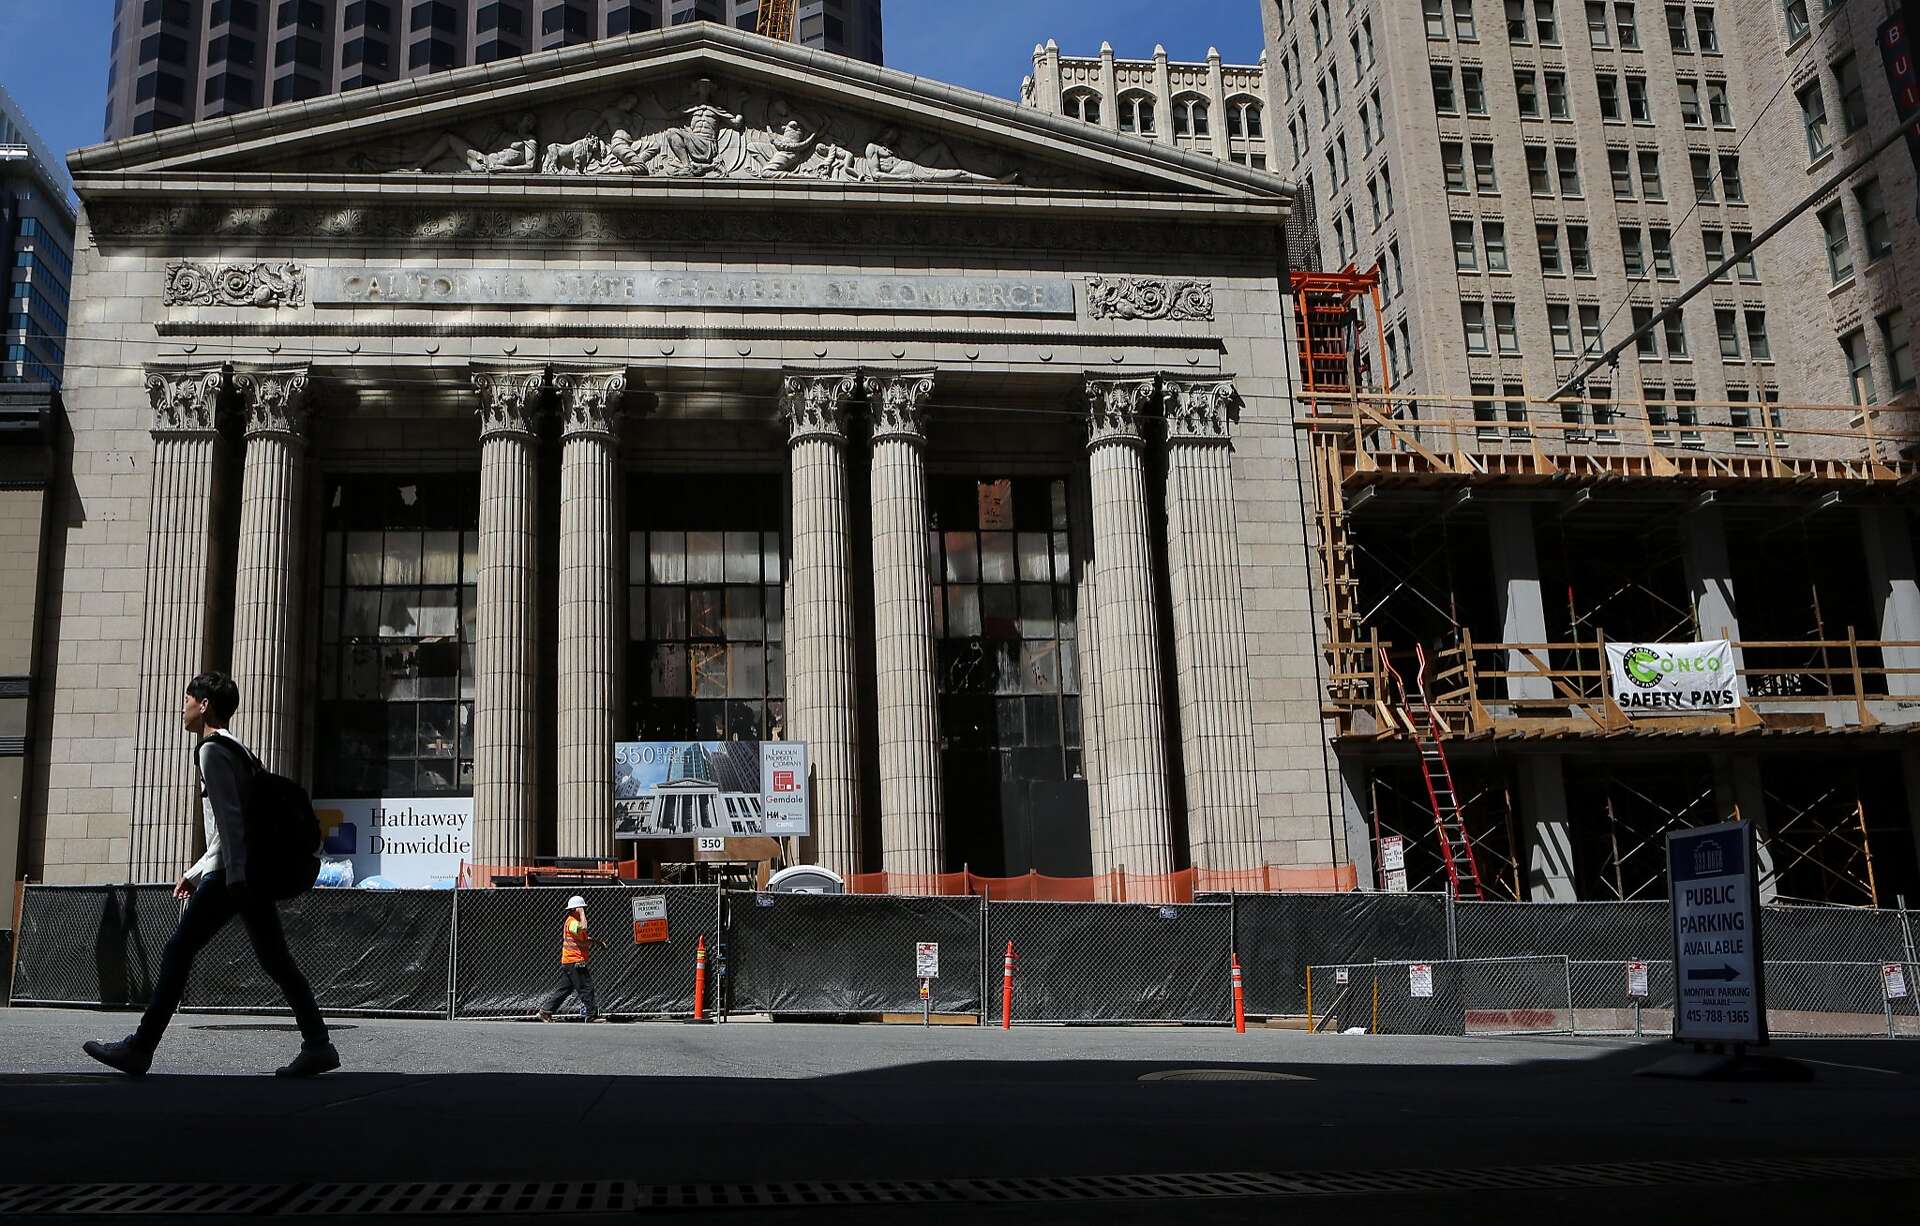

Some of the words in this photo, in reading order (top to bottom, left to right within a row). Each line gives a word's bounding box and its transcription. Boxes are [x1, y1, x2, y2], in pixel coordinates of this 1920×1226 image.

[343, 273, 531, 299] CALIFORNIA
[554, 275, 635, 299] STATE
[654, 276, 806, 301] CHAMBER
[827, 280, 860, 301] OF
[878, 280, 1043, 305] COMMERCE
[1619, 691, 1683, 708] SAFETY
[1691, 690, 1734, 706] PAYS
[615, 745, 655, 765] 350
[657, 755, 690, 764] STREET
[765, 794, 804, 804] Gemdale
[369, 807, 468, 831] Hathaway
[369, 834, 471, 855] Dinwiddie
[701, 839, 721, 849] 350
[1685, 884, 1736, 907] PUBLIC
[1680, 911, 1745, 934] PARKING
[1683, 939, 1744, 956] AVAILABLE
[1684, 987, 1715, 998] MONTHLY
[1718, 987, 1750, 997] PARKING
[1686, 1009, 1749, 1024] 415-788-1365
